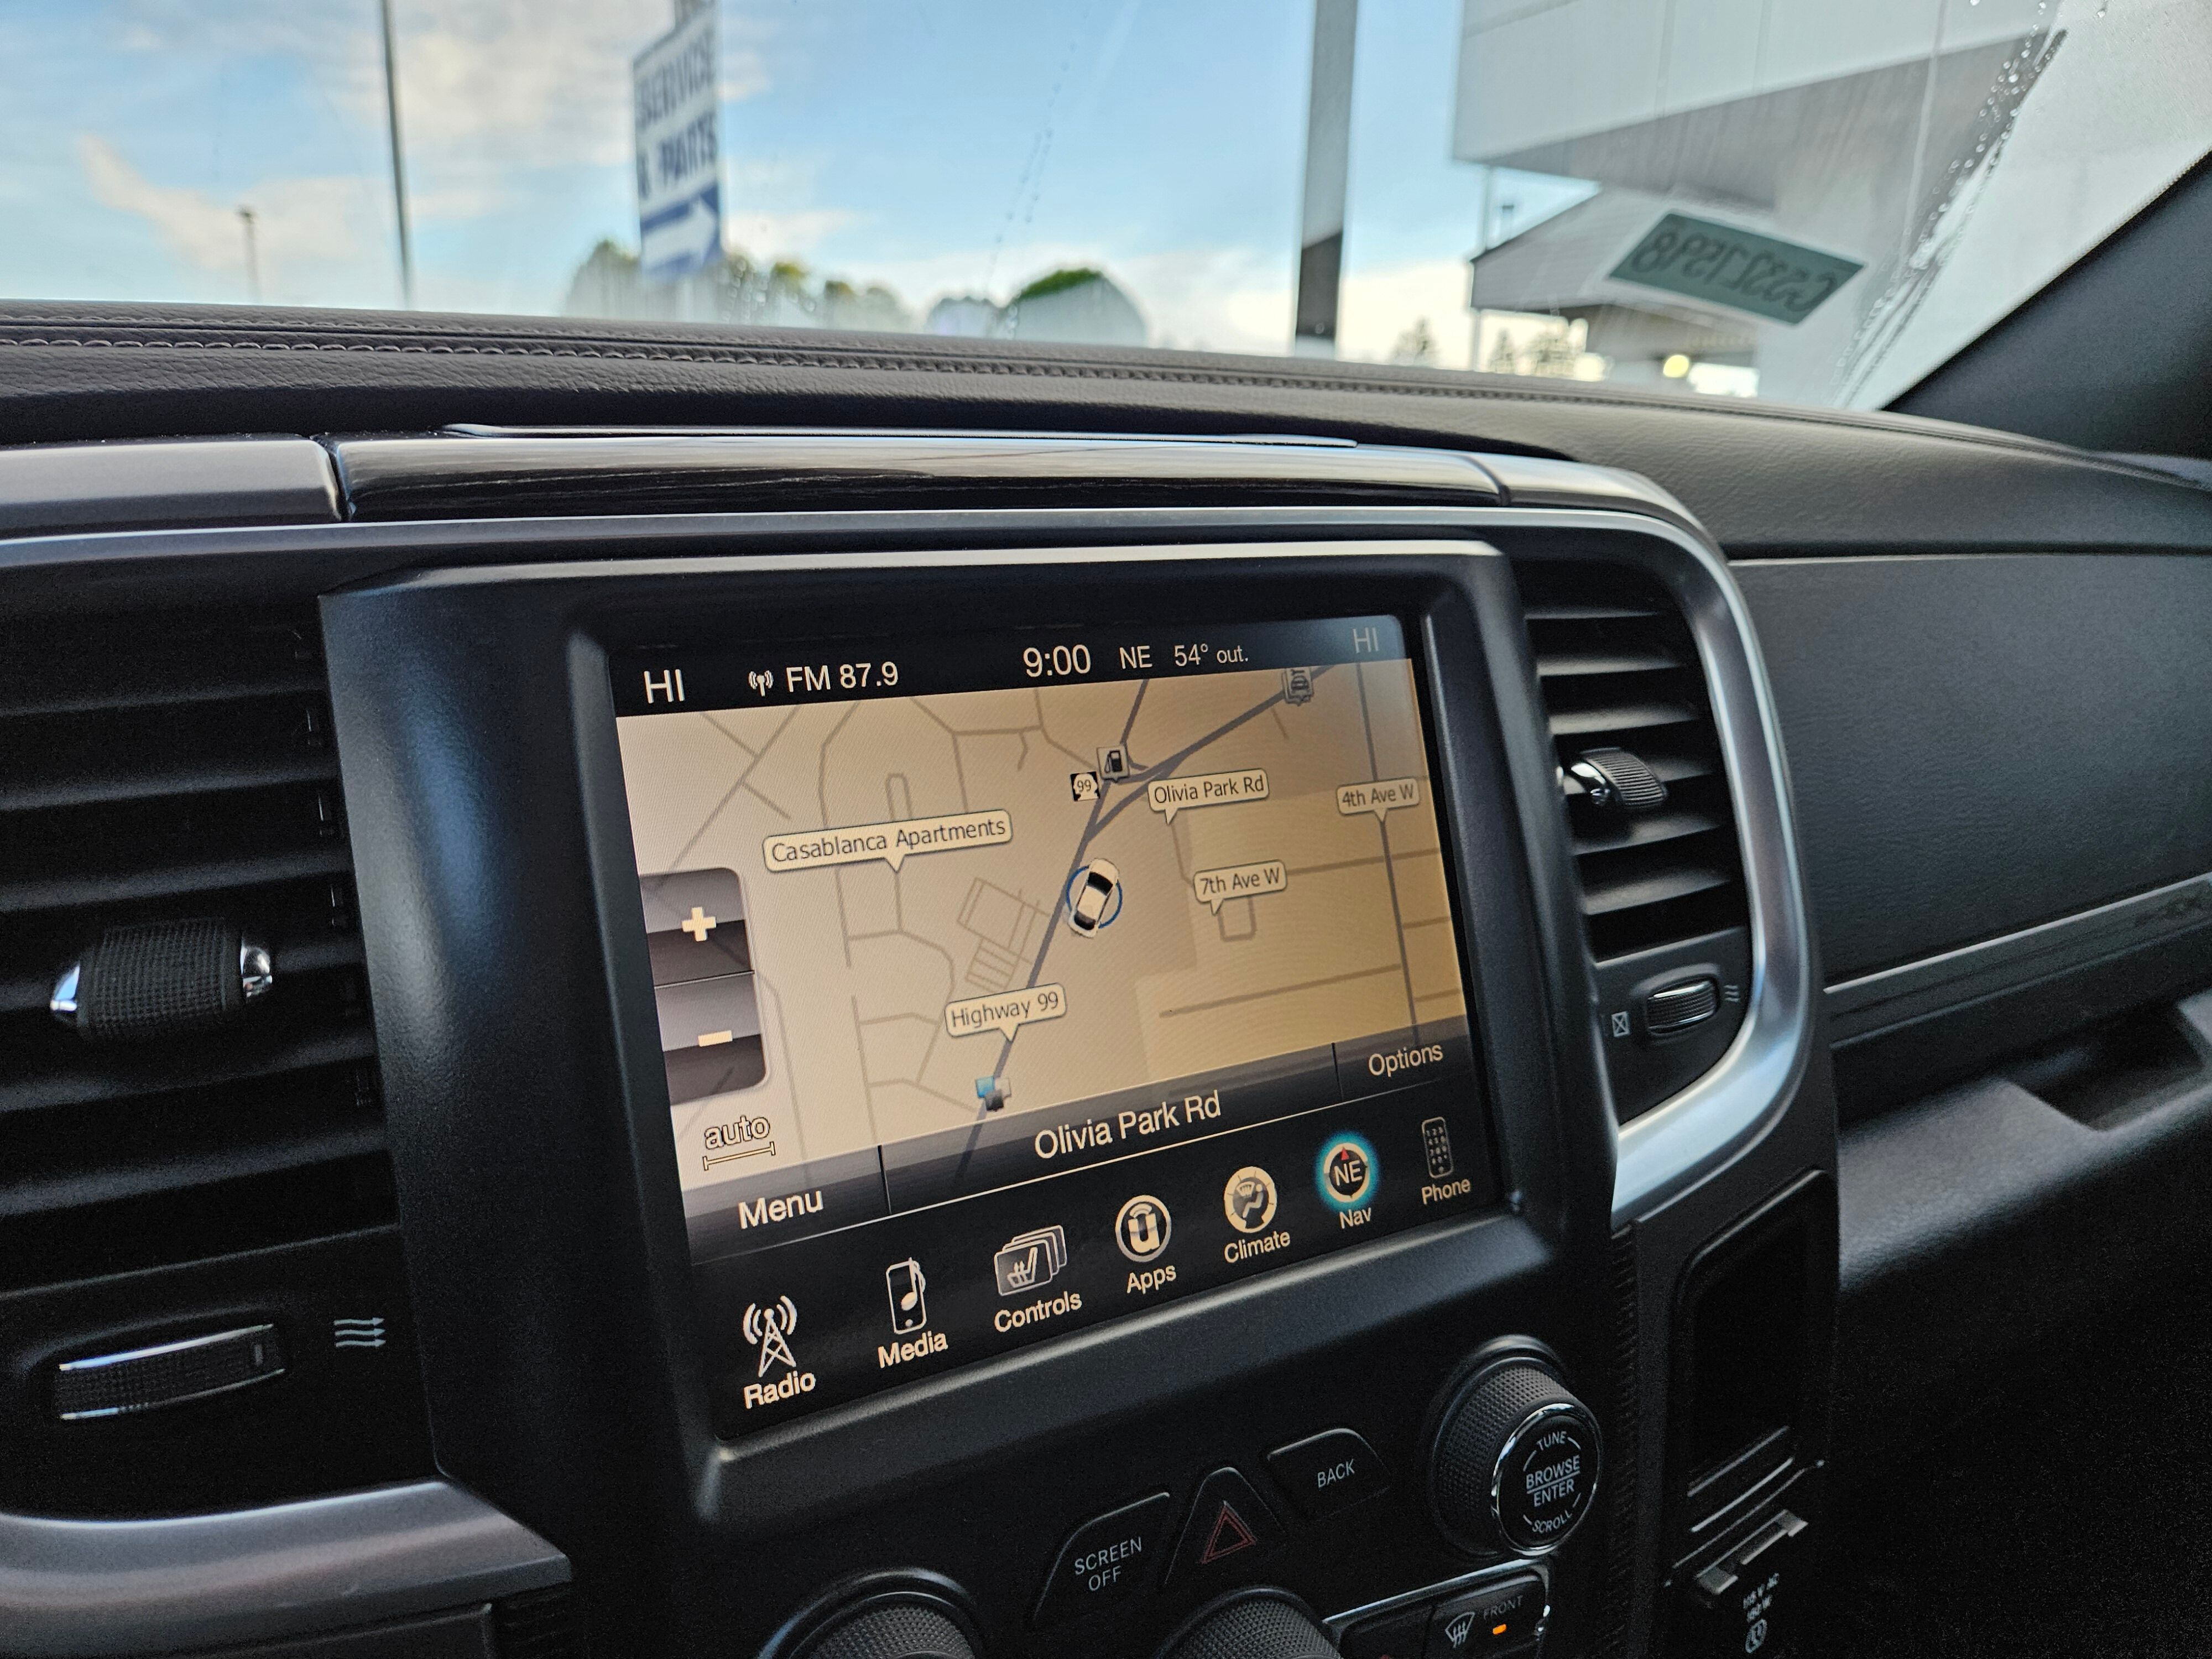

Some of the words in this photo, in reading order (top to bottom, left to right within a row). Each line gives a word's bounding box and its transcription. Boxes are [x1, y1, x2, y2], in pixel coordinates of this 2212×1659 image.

[1216, 645, 1249, 664] out.
[1353, 627, 1379, 654] HI
[1023, 644, 1092, 677] 9:00
[1119, 645, 1152, 669] NE
[644, 669, 685, 703] HI
[786, 664, 831, 692] FM
[840, 661, 899, 689] 87.9
[1077, 780, 1093, 793] 99
[1154, 784, 1199, 804] Olivia
[1203, 781, 1240, 799] Park
[1244, 776, 1265, 793] Rd
[1342, 790, 1367, 807] 4th
[1371, 788, 1395, 804] Ave
[1398, 784, 1415, 800] W
[771, 832, 888, 864] Casablanca
[896, 818, 1006, 848] Apartments
[1201, 875, 1227, 894] 7th
[1232, 872, 1260, 889] Ave
[1264, 867, 1281, 884] W
[951, 998, 1032, 1029] Highway
[1037, 991, 1060, 1010] 99
[1368, 1042, 1443, 1077] Options
[703, 1113, 771, 1150] auto
[1035, 1121, 1113, 1160] Olivia
[1119, 1102, 1181, 1141] Park
[1185, 1089, 1222, 1123] Rd
[1334, 1161, 1363, 1186] NE
[1421, 1176, 1472, 1205] Phone
[738, 1190, 825, 1229] Menu
[1339, 1206, 1372, 1229] Nav
[1224, 1229, 1291, 1264] Climate
[1126, 1263, 1177, 1295] Apps
[994, 1291, 1083, 1332] Controls
[878, 1329, 948, 1369] Media
[743, 1369, 816, 1409] Radio
[1536, 1431, 1567, 1451] TUNE
[1317, 1458, 1355, 1489] BACK
[1526, 1454, 1581, 1489] BROWSE
[1533, 1479, 1575, 1507] ENTER
[1532, 1510, 1572, 1534] SCROLL
[1074, 1536, 1143, 1577] SCREEN
[1088, 1565, 1123, 1594] OFF
[1483, 1594, 1525, 1621] FRONT
